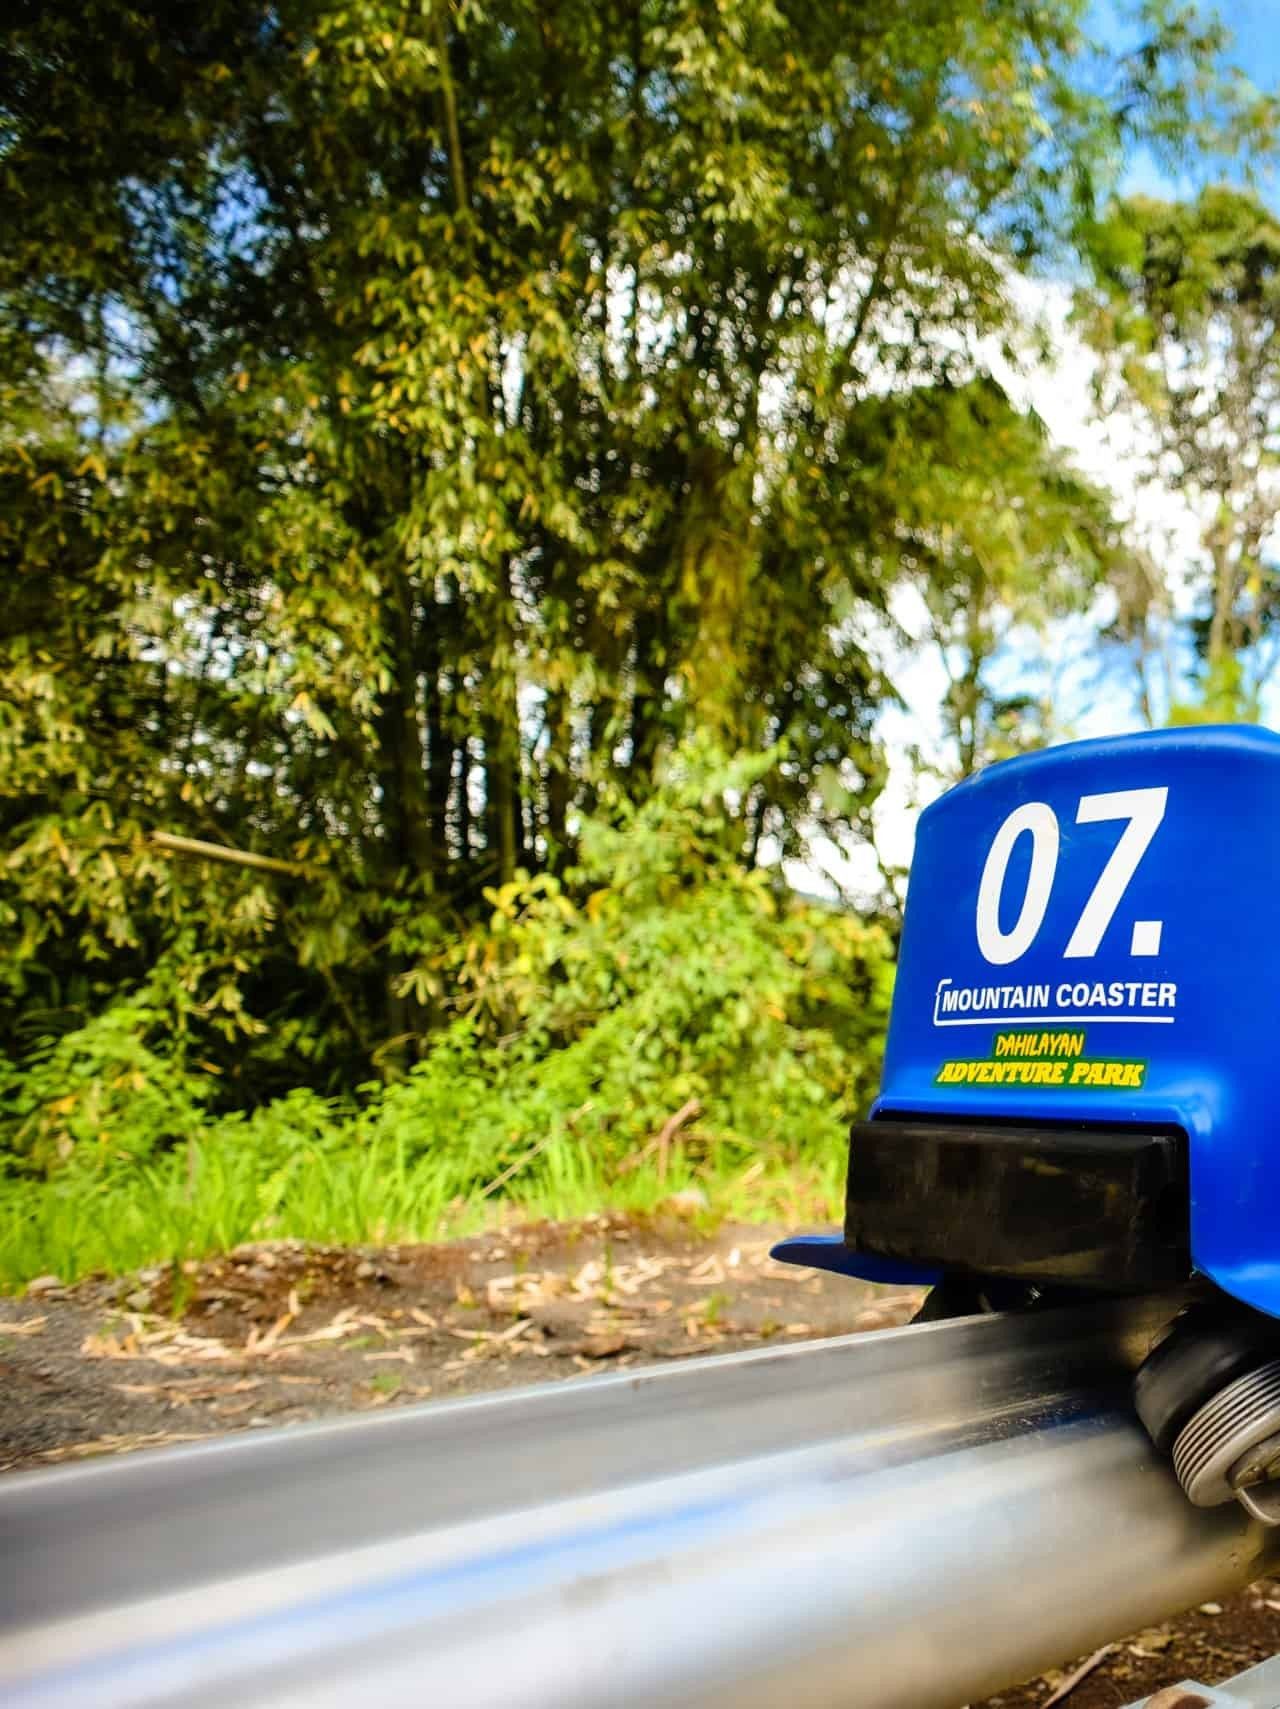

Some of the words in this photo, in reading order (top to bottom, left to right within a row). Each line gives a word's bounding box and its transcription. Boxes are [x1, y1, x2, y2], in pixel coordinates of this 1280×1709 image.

[976, 786, 1169, 965] 07.
[942, 985, 1049, 1012] MOUNTAIN
[1055, 983, 1177, 1007] COASTER
[994, 1033, 1084, 1057] DAHILAYAN
[937, 1062, 1067, 1083] ADVENTURE
[1069, 1062, 1144, 1086] PARK
